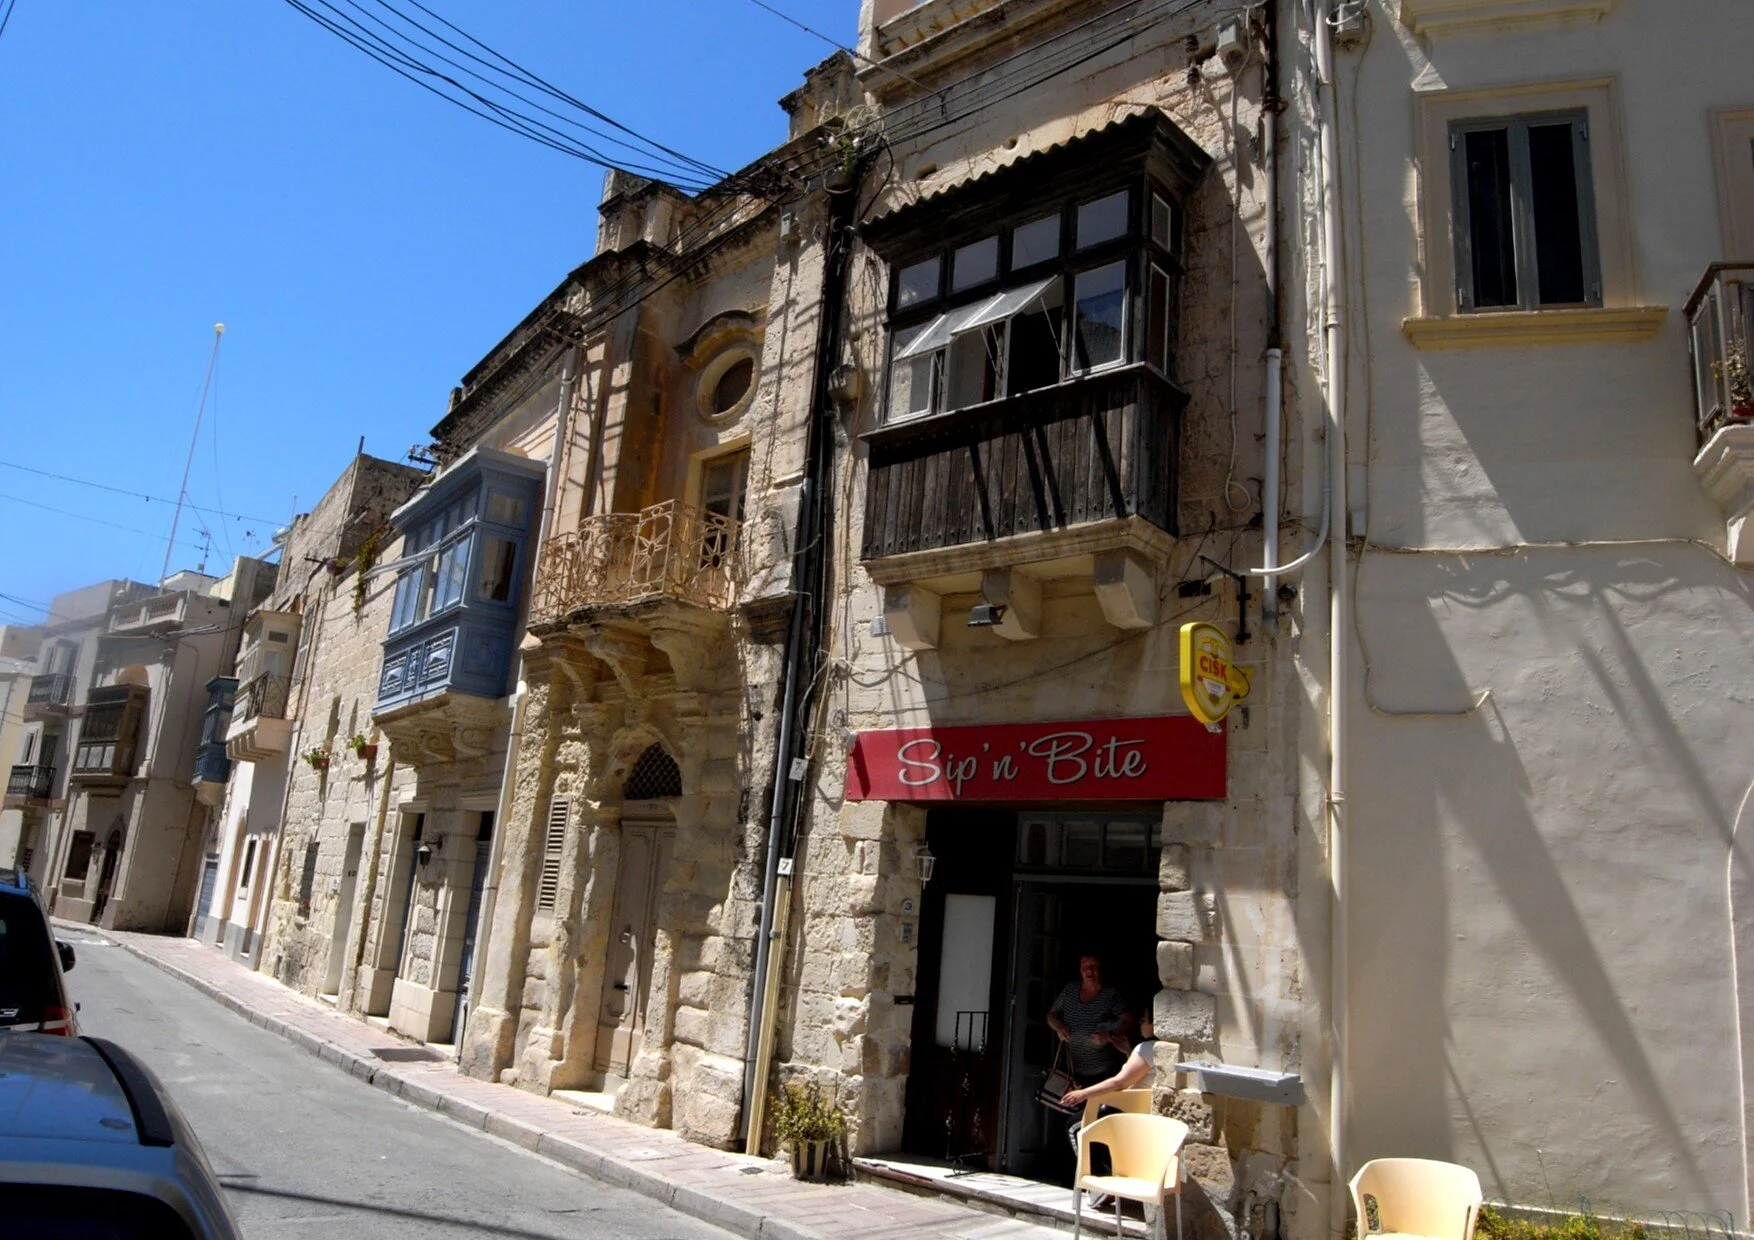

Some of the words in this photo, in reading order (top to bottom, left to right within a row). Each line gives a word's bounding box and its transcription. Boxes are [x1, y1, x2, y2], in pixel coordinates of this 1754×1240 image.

[1200, 656, 1228, 682] CISK
[897, 738, 977, 796] Sip
[1028, 731, 1147, 784] Bite
[781, 861, 790, 871] 7
